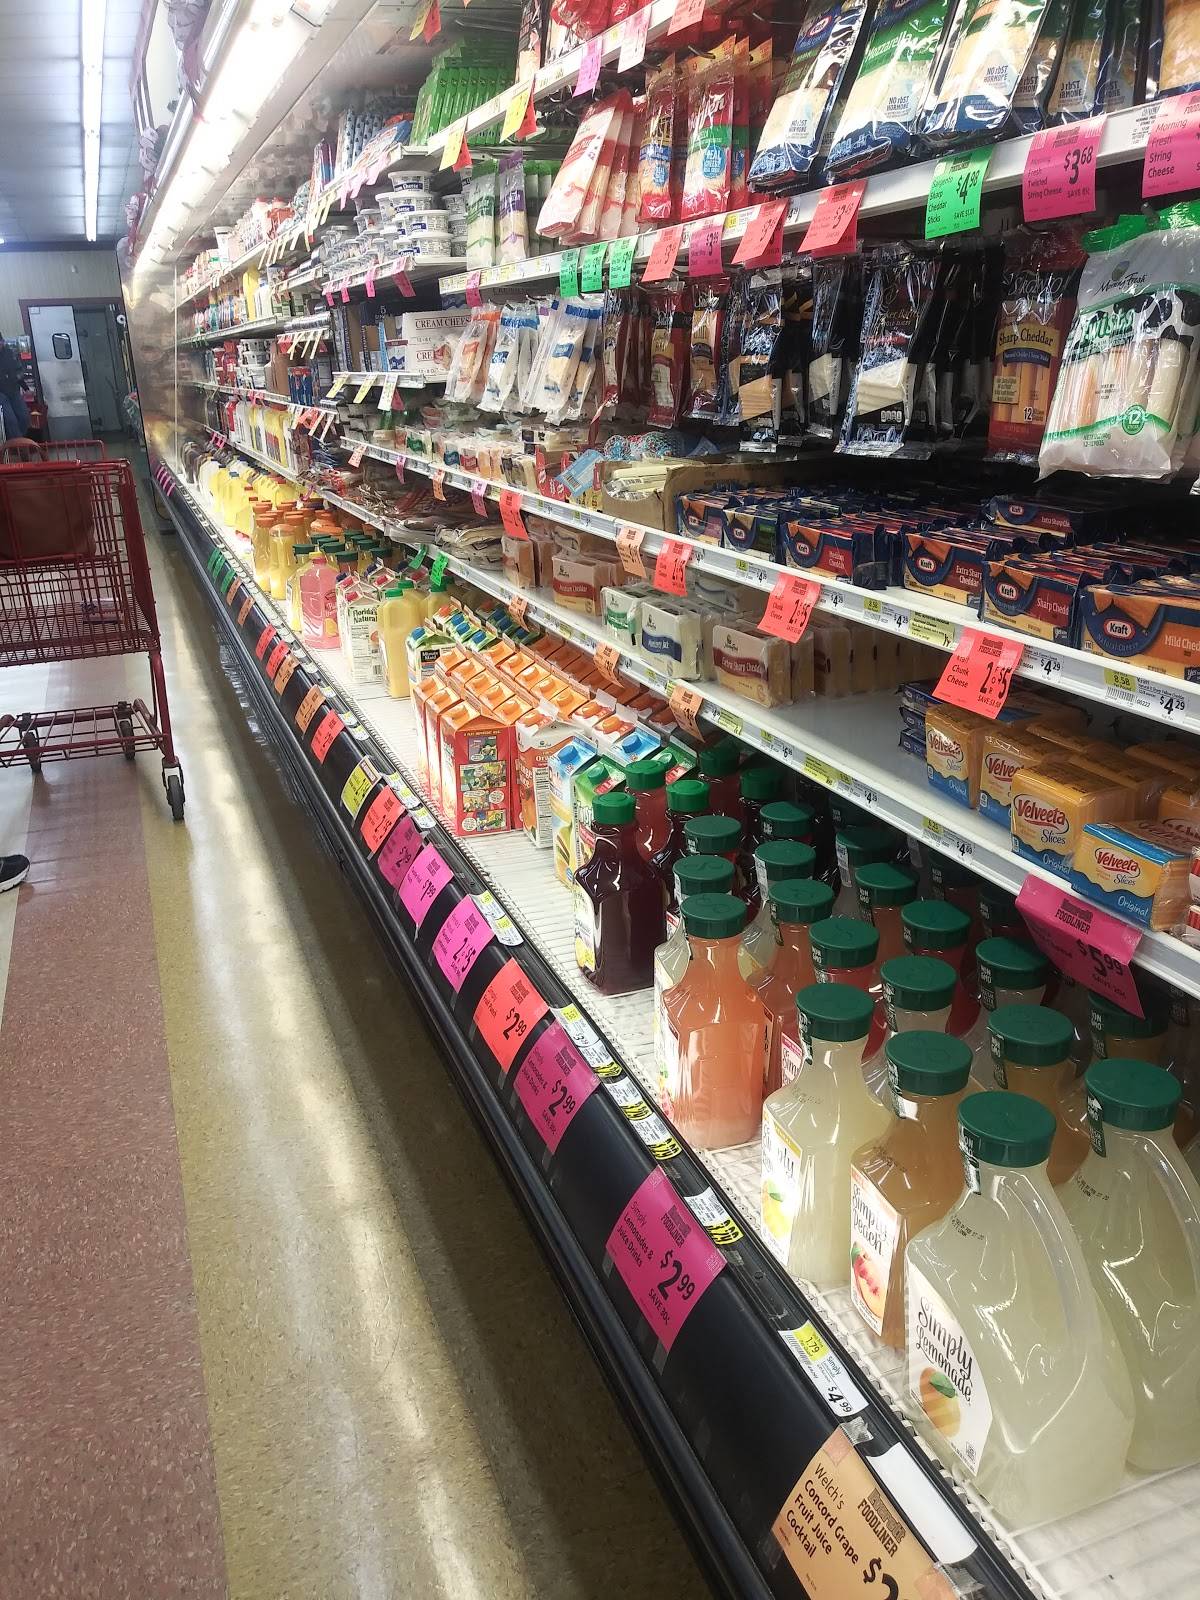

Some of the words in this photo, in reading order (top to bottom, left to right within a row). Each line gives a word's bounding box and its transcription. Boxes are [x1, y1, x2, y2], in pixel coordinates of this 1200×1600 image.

[1156, 120, 1187, 132] Morning
[1152, 136, 1172, 148] Fresh
[1150, 150, 1172, 162] String
[1148, 166, 1174, 178] Cheese
[1028, 177, 1048, 186] Twisted
[1028, 189, 1042, 200] String
[1043, 187, 1063, 196] Cheese
[928, 202, 948, 212] Cheddar
[928, 215, 941, 224] Sticks
[1125, 272, 1146, 288] Fresh
[415, 319, 444, 330] CREAM
[444, 316, 471, 328] CHEES
[1000, 333, 1018, 346] Sharp
[1020, 328, 1053, 346] Cheddar
[416, 352, 434, 360] CRE
[1024, 406, 1032, 420] 12
[1127, 408, 1142, 424] 12
[920, 559, 932, 568] Kraft
[956, 566, 968, 576] Extra
[960, 575, 979, 587] Cheddar
[1001, 586, 1014, 598] Kraft
[1037, 598, 1052, 611] Sharp
[353, 615, 378, 624] Natural
[1110, 622, 1128, 636] Kraft
[1164, 634, 1181, 647] Mild
[952, 664, 970, 677] Chunk
[980, 661, 994, 694] 2
[946, 674, 969, 688] Cheese
[1114, 675, 1130, 686] 8.58
[1160, 695, 1185, 715] $429
[1017, 799, 1066, 826] Velveeta
[1040, 829, 1066, 845] Slices
[1042, 854, 1072, 876] Original
[1096, 850, 1139, 873] Velveeta
[1114, 874, 1136, 887] Slices
[1118, 895, 1149, 916] Original
[1055, 908, 1091, 934] FOODLINER
[502, 1007, 528, 1040] $299
[548, 1079, 576, 1117] $299
[631, 1201, 647, 1228] Simply
[624, 1212, 650, 1255] Lemonades
[648, 1250, 654, 1260] &
[660, 1212, 685, 1248] FOODLINER
[853, 1208, 883, 1256] Peach
[616, 1226, 630, 1246] Juice
[628, 1242, 642, 1268] Drinks
[657, 1248, 696, 1301] $299
[648, 1288, 662, 1310] SAVE
[806, 1336, 820, 1354] 1.79
[918, 1296, 973, 1381] Simply
[826, 1356, 842, 1376] Simply
[916, 1325, 974, 1403] Lemonade
[828, 1386, 852, 1414] $499
[814, 1462, 845, 1511] Welch's
[794, 1493, 814, 1524] Fruit
[812, 1522, 832, 1556] Juice
[804, 1479, 836, 1529] Concord
[834, 1526, 859, 1565] Grape
[857, 1498, 899, 1558] FOODLINER
[786, 1509, 817, 1559] Cocktail
